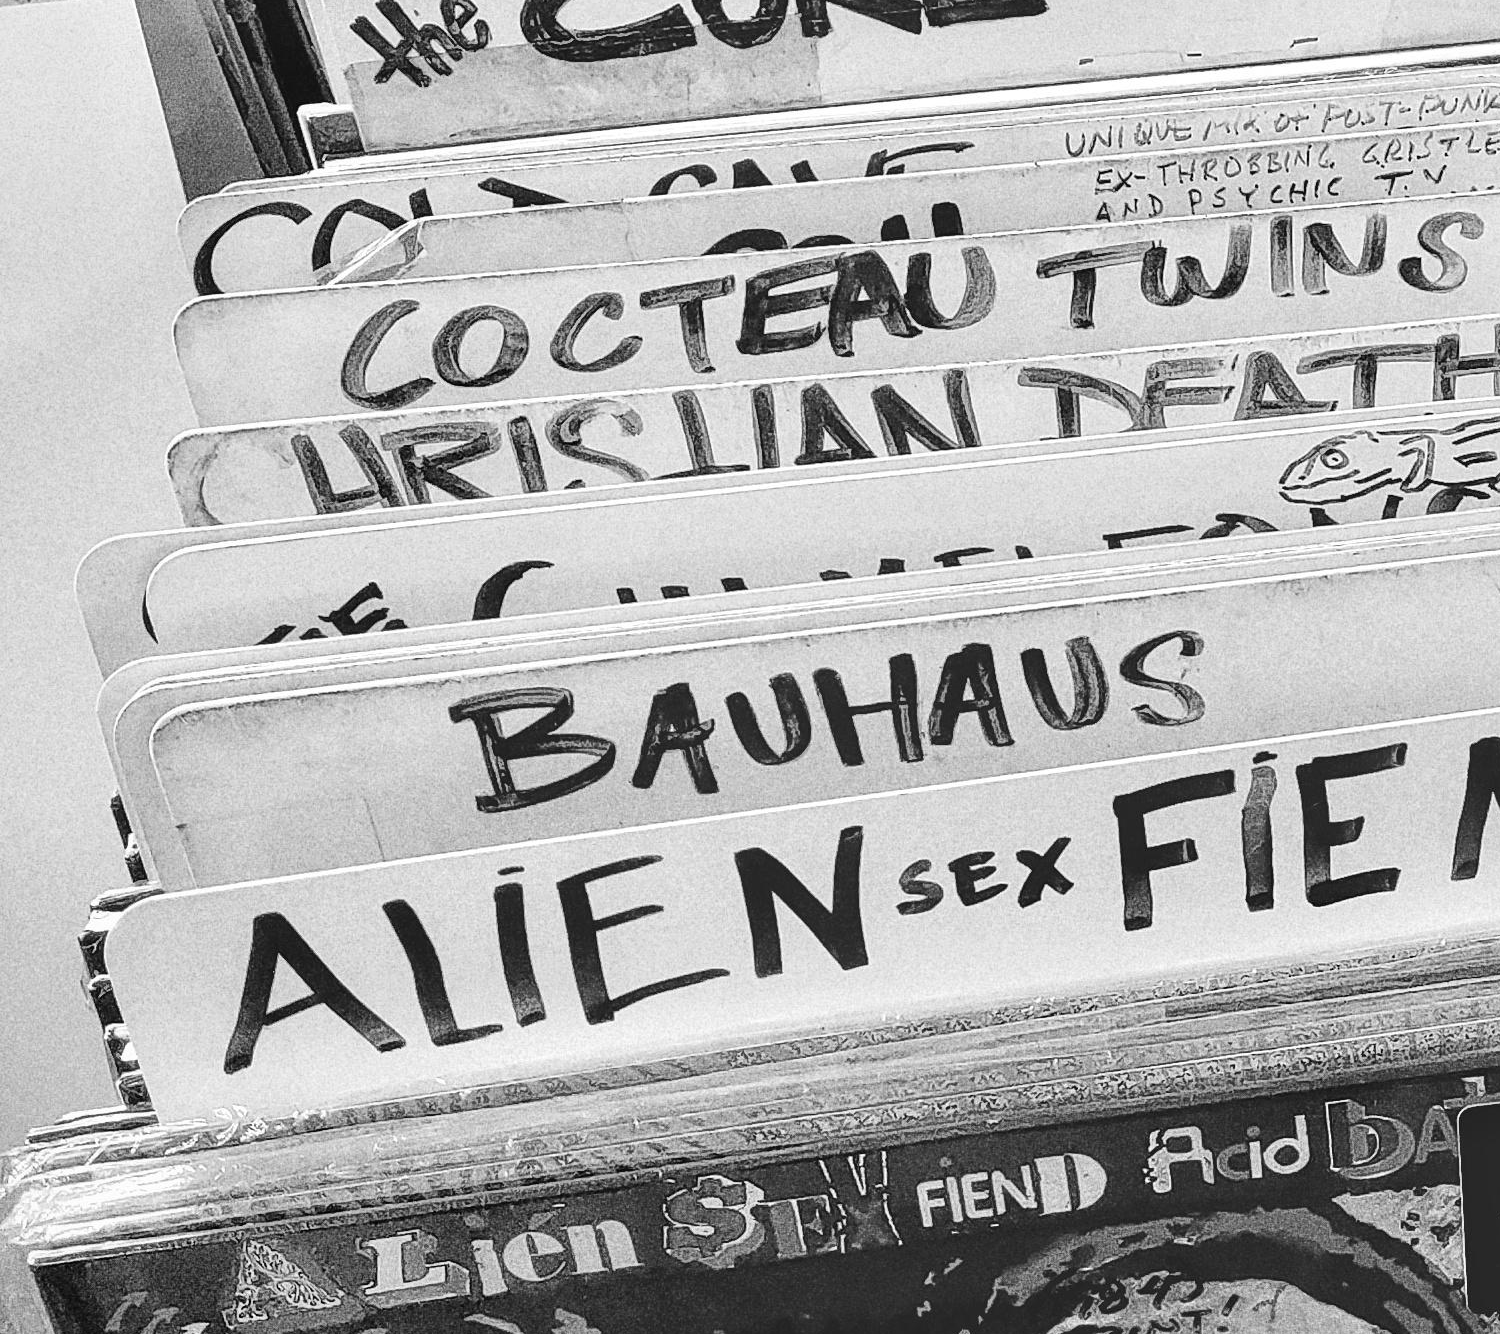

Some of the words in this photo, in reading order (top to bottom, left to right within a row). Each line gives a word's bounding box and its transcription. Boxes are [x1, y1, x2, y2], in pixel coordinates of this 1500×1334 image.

[1064, 123, 1193, 158] UNIQUE
[1095, 142, 1337, 196] EX-THROBBING
[1096, 191, 1166, 224] AND
[1189, 175, 1344, 211] PSYCHIC
[339, 246, 1001, 412] COCTEAU
[1036, 209, 1487, 330] TWINS
[448, 629, 1207, 813] BAUHAUS
[895, 835, 1075, 916] SEX
[914, 1153, 1109, 1229] FIEND
[1142, 1114, 1308, 1196] Acid
